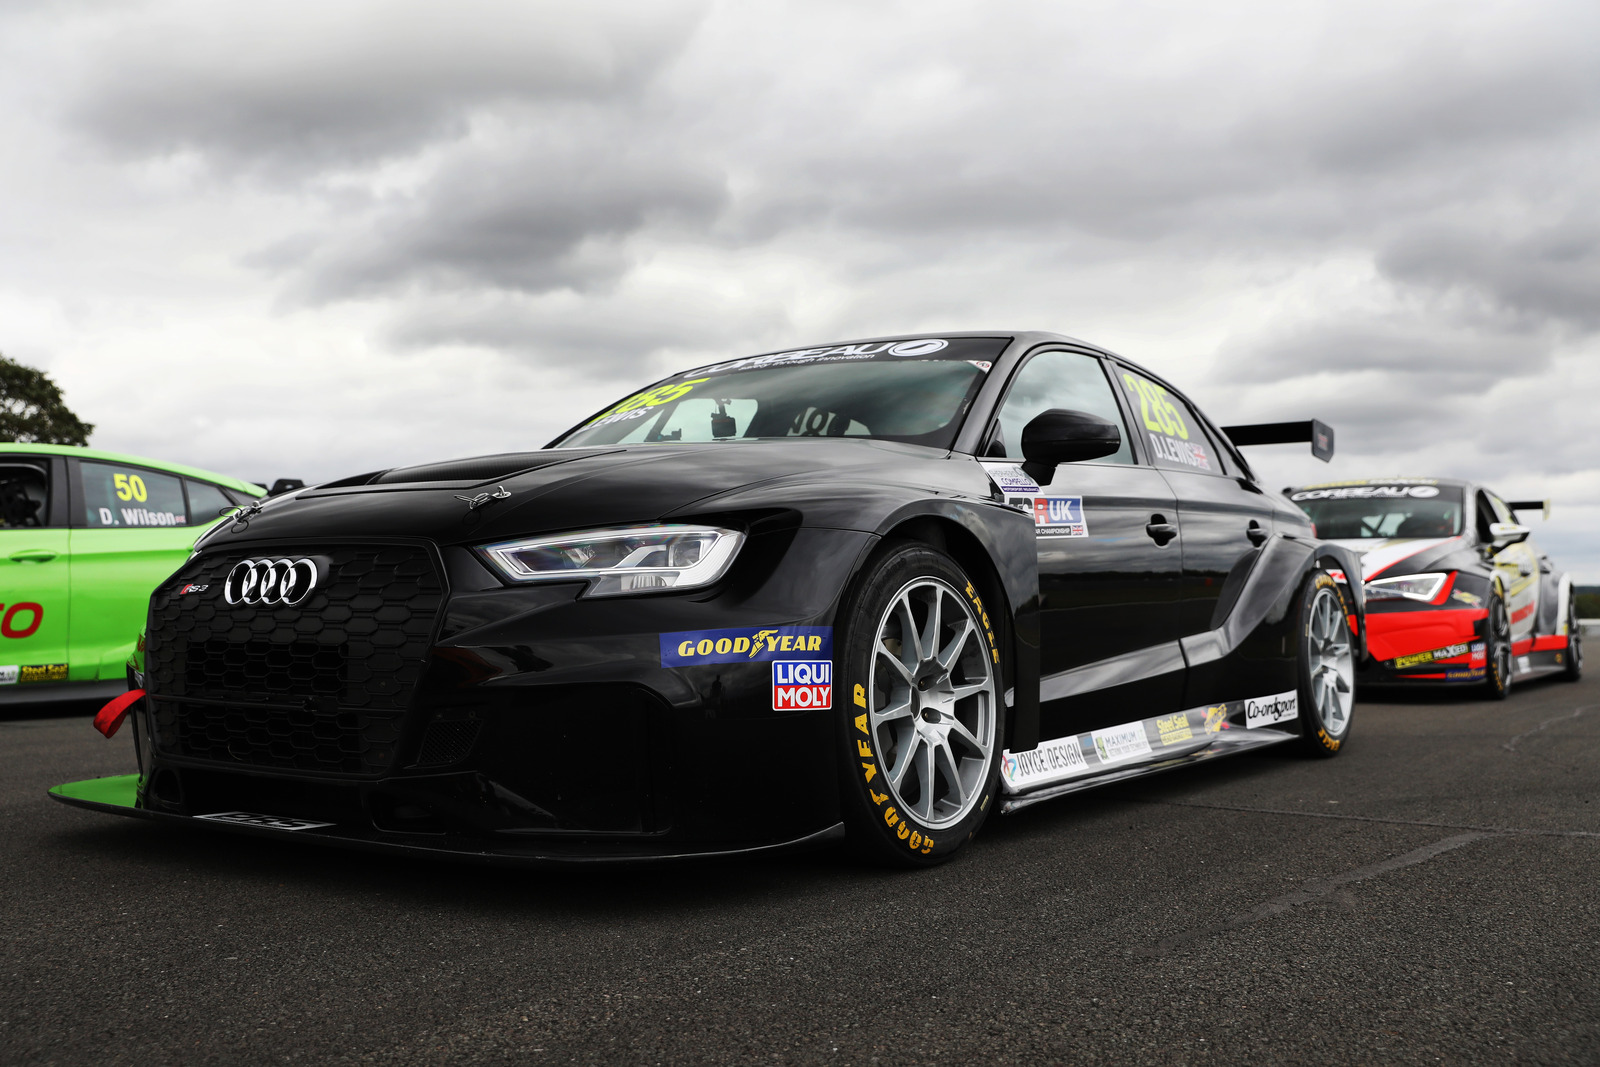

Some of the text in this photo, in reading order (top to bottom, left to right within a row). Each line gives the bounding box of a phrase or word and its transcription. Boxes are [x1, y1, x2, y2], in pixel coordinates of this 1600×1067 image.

[1123, 374, 1188, 440] 285
[113, 473, 147, 502] 50
[1291, 487, 1410, 501] CORBEAU
[99, 507, 176, 525] D. Wilson
[777, 664, 829, 685] LIQUI
[778, 687, 830, 707] MOLY
[1105, 731, 1136, 748] MAXIMUM
[1017, 750, 1048, 776] JOYCE
[1047, 742, 1083, 769] DESIGN
